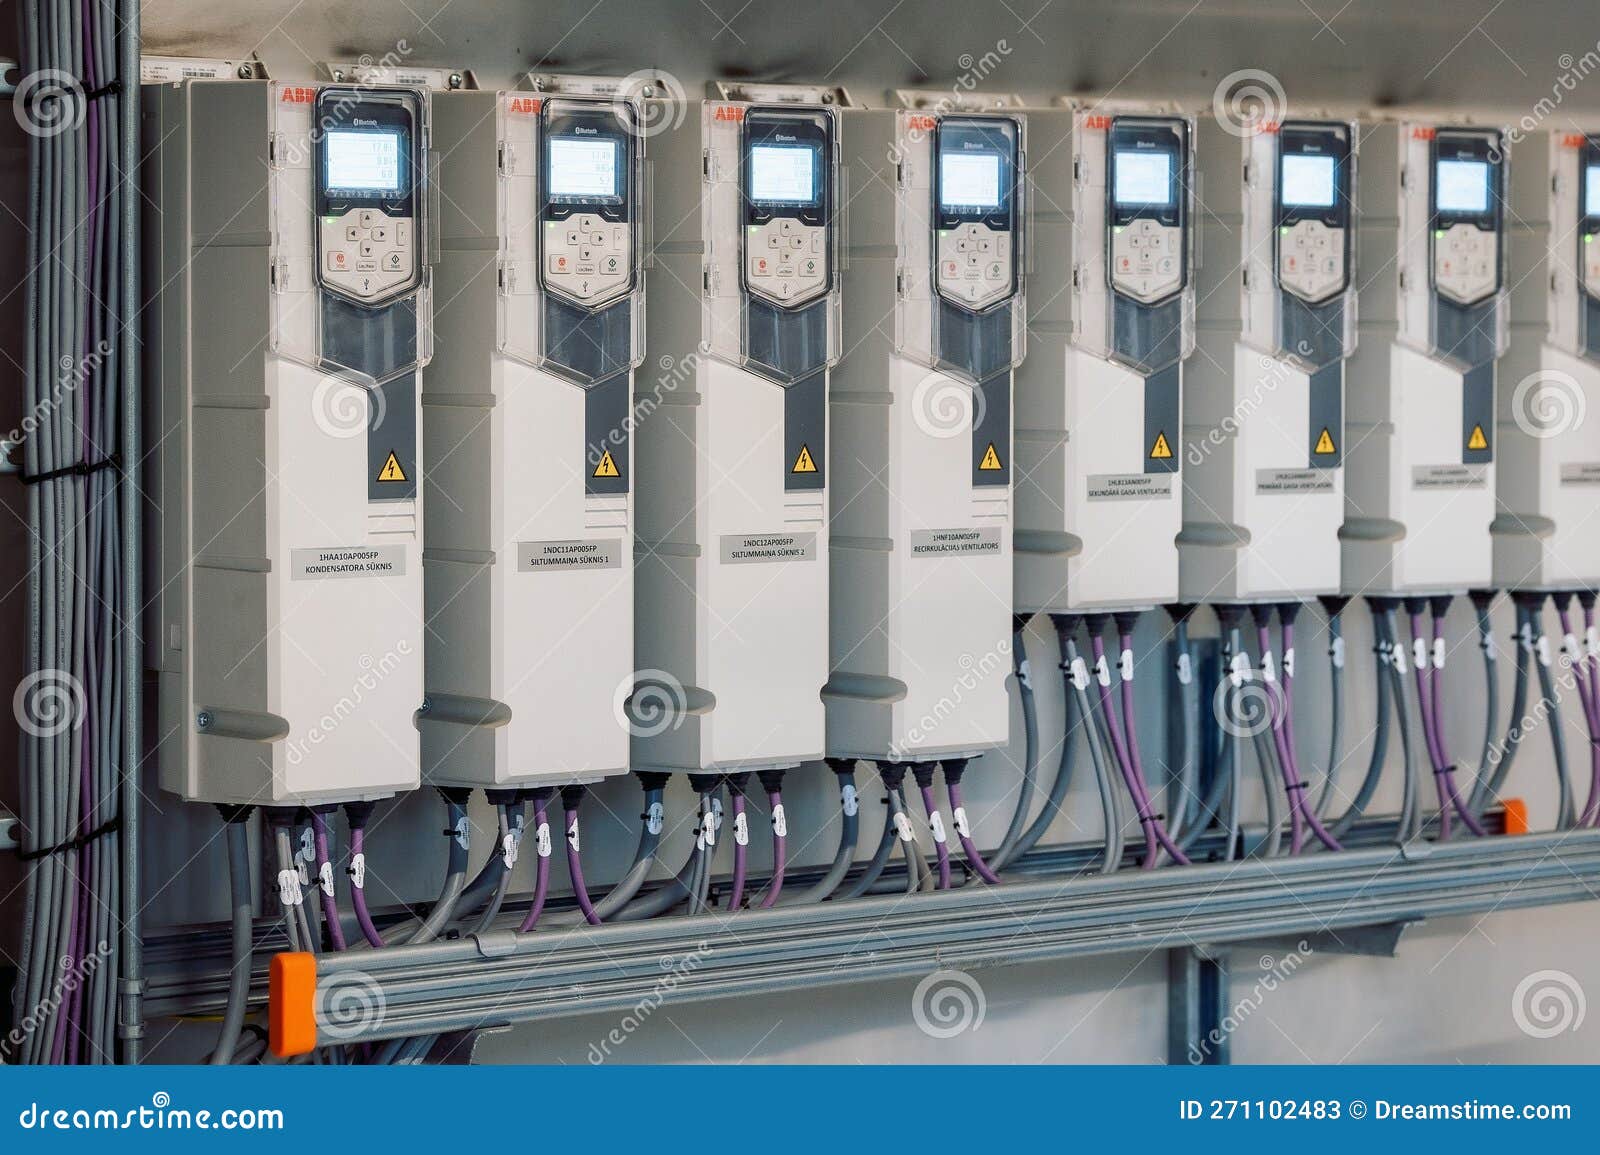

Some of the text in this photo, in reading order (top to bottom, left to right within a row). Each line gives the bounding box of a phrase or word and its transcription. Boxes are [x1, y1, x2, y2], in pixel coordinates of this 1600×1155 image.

[283, 87, 315, 103] ABB
[511, 99, 542, 113] ABB
[715, 106, 745, 121] ABB
[1086, 117, 1110, 129] ABB
[543, 545, 597, 554] 1NDC11AP005FP
[777, 547, 800, 557] SŪKNIS
[960, 543, 999, 551] VENTILATORS
[319, 551, 379, 561] 1HAA10AP005FP
[579, 555, 604, 564] SŪKNIS
[305, 562, 392, 574] KONDENSATORA SŪKNIS
